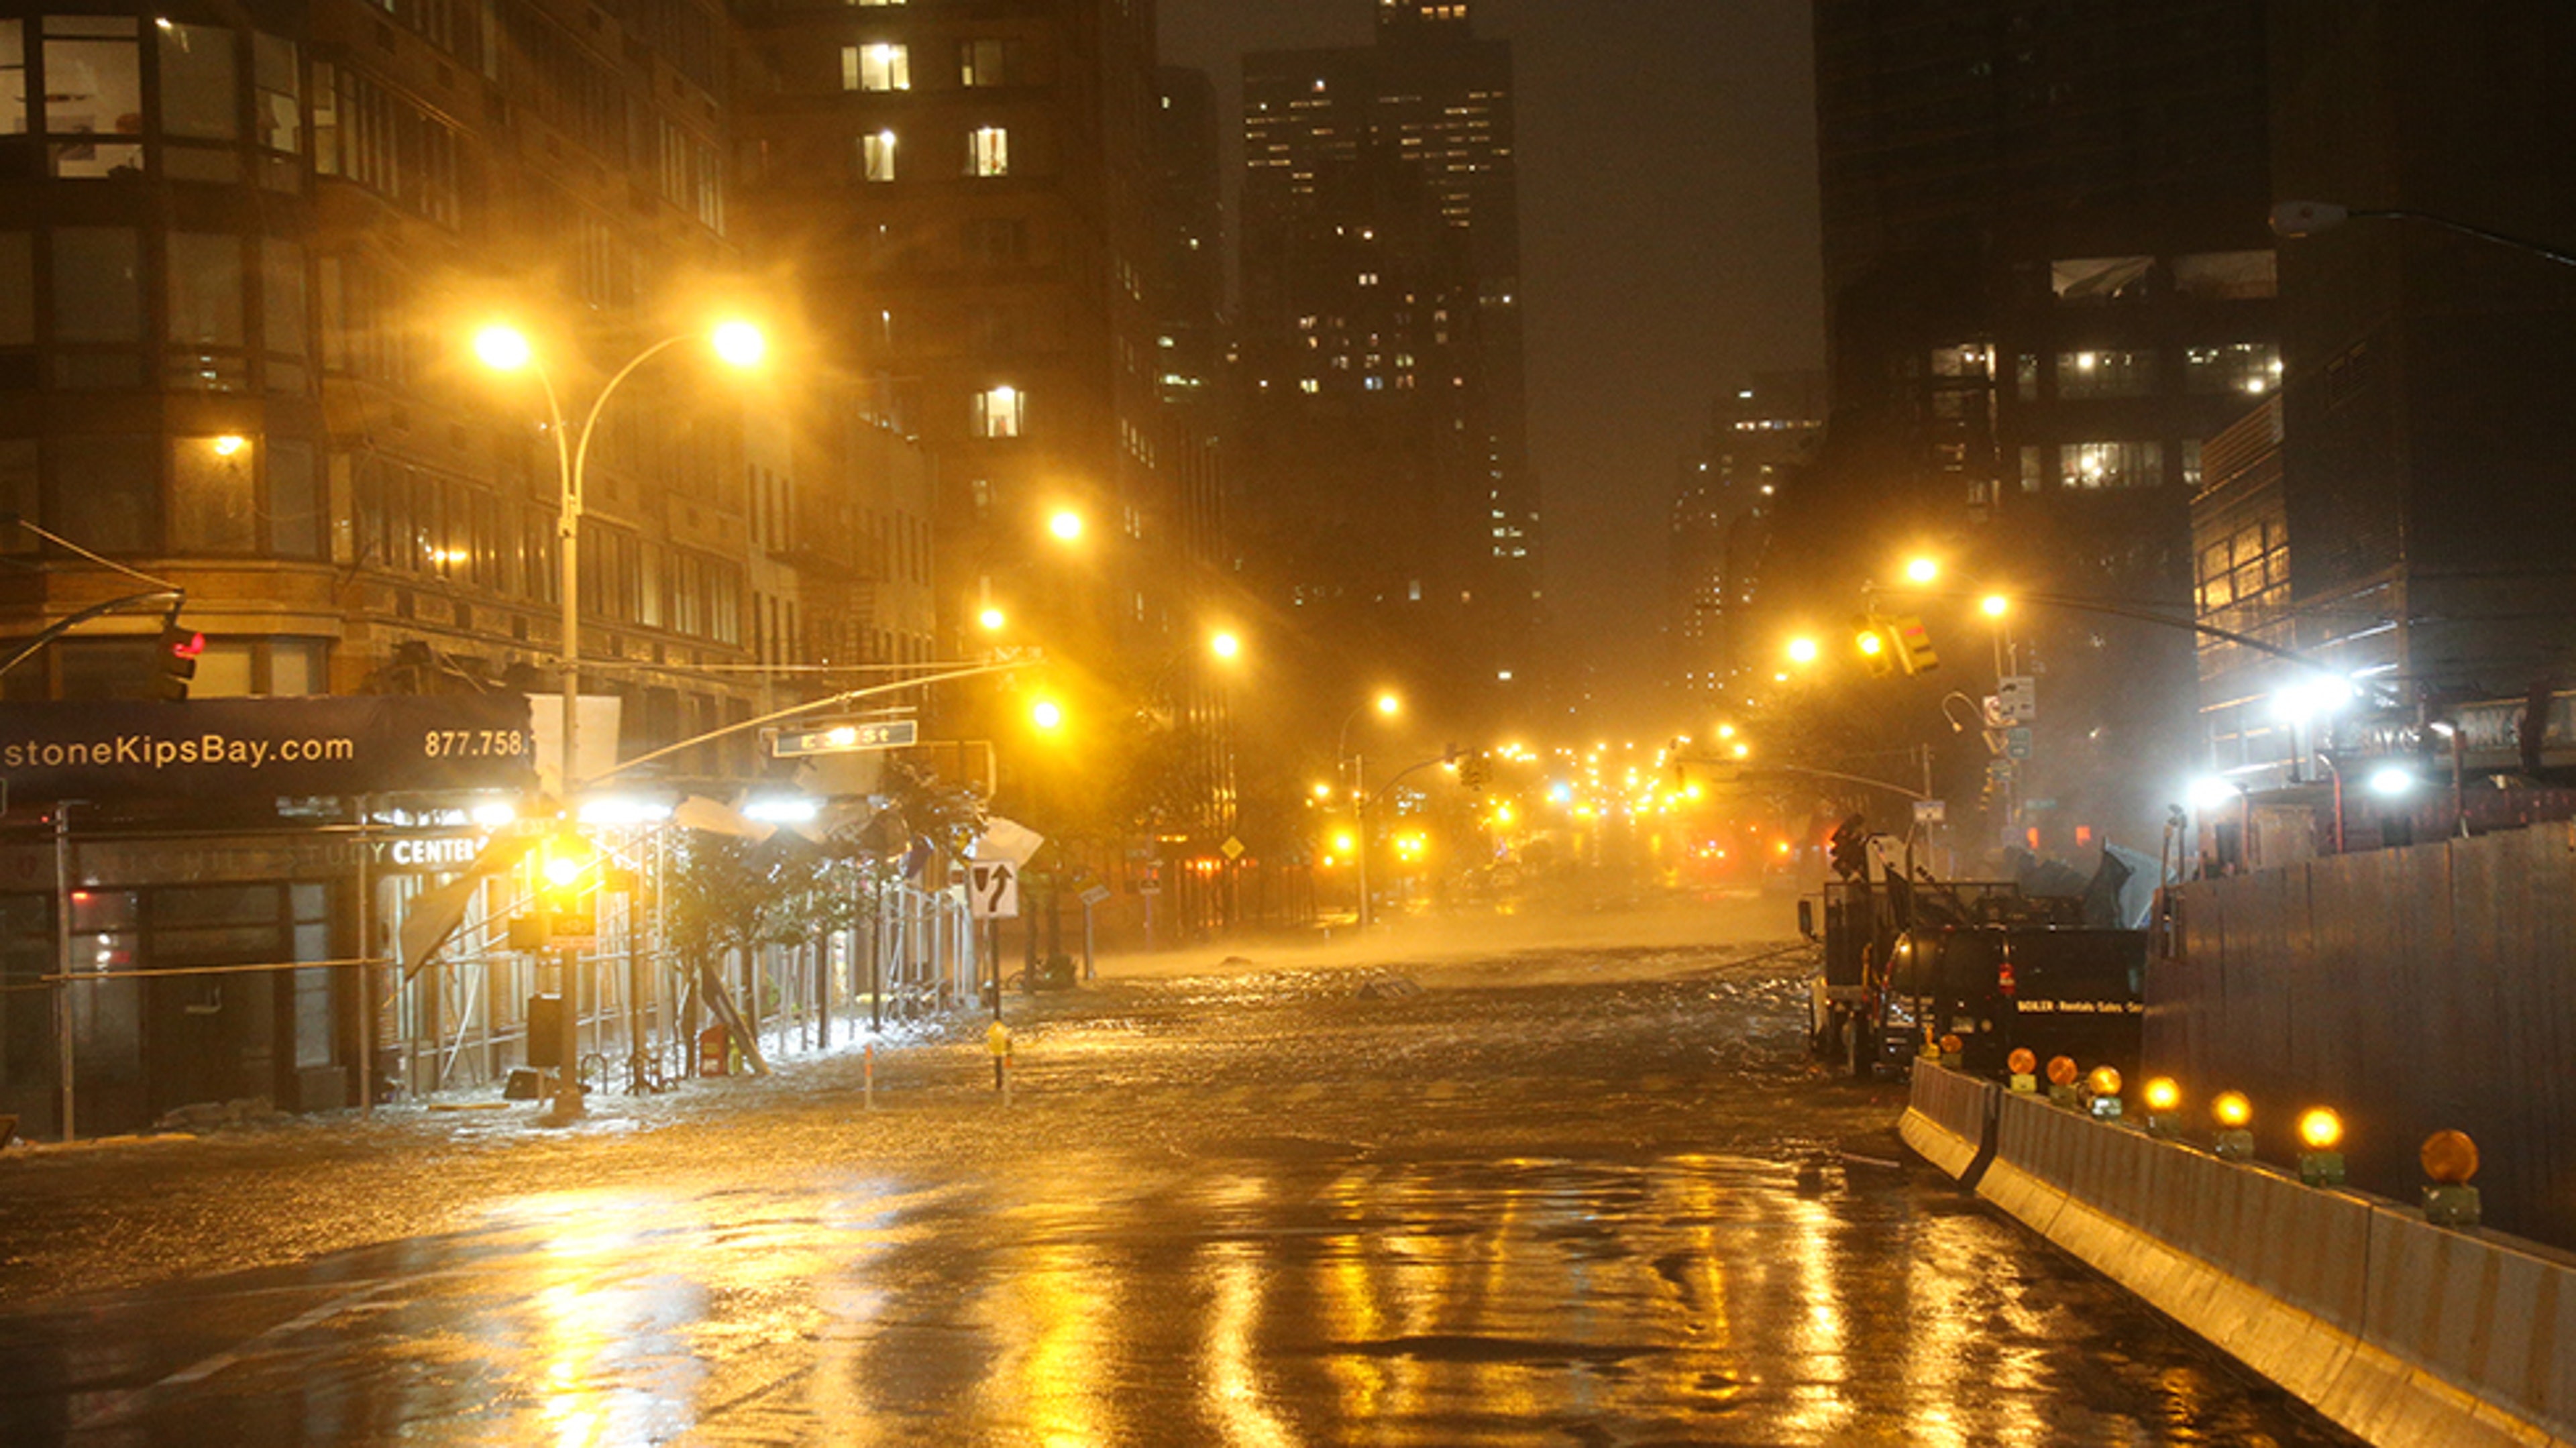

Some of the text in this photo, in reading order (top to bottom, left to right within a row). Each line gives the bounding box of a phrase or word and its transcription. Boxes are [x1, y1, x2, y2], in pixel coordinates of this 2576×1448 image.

[425, 730, 536, 757] 877.758.
[863, 728, 890, 744] St
[4, 734, 354, 769] stoneKipsBay.com
